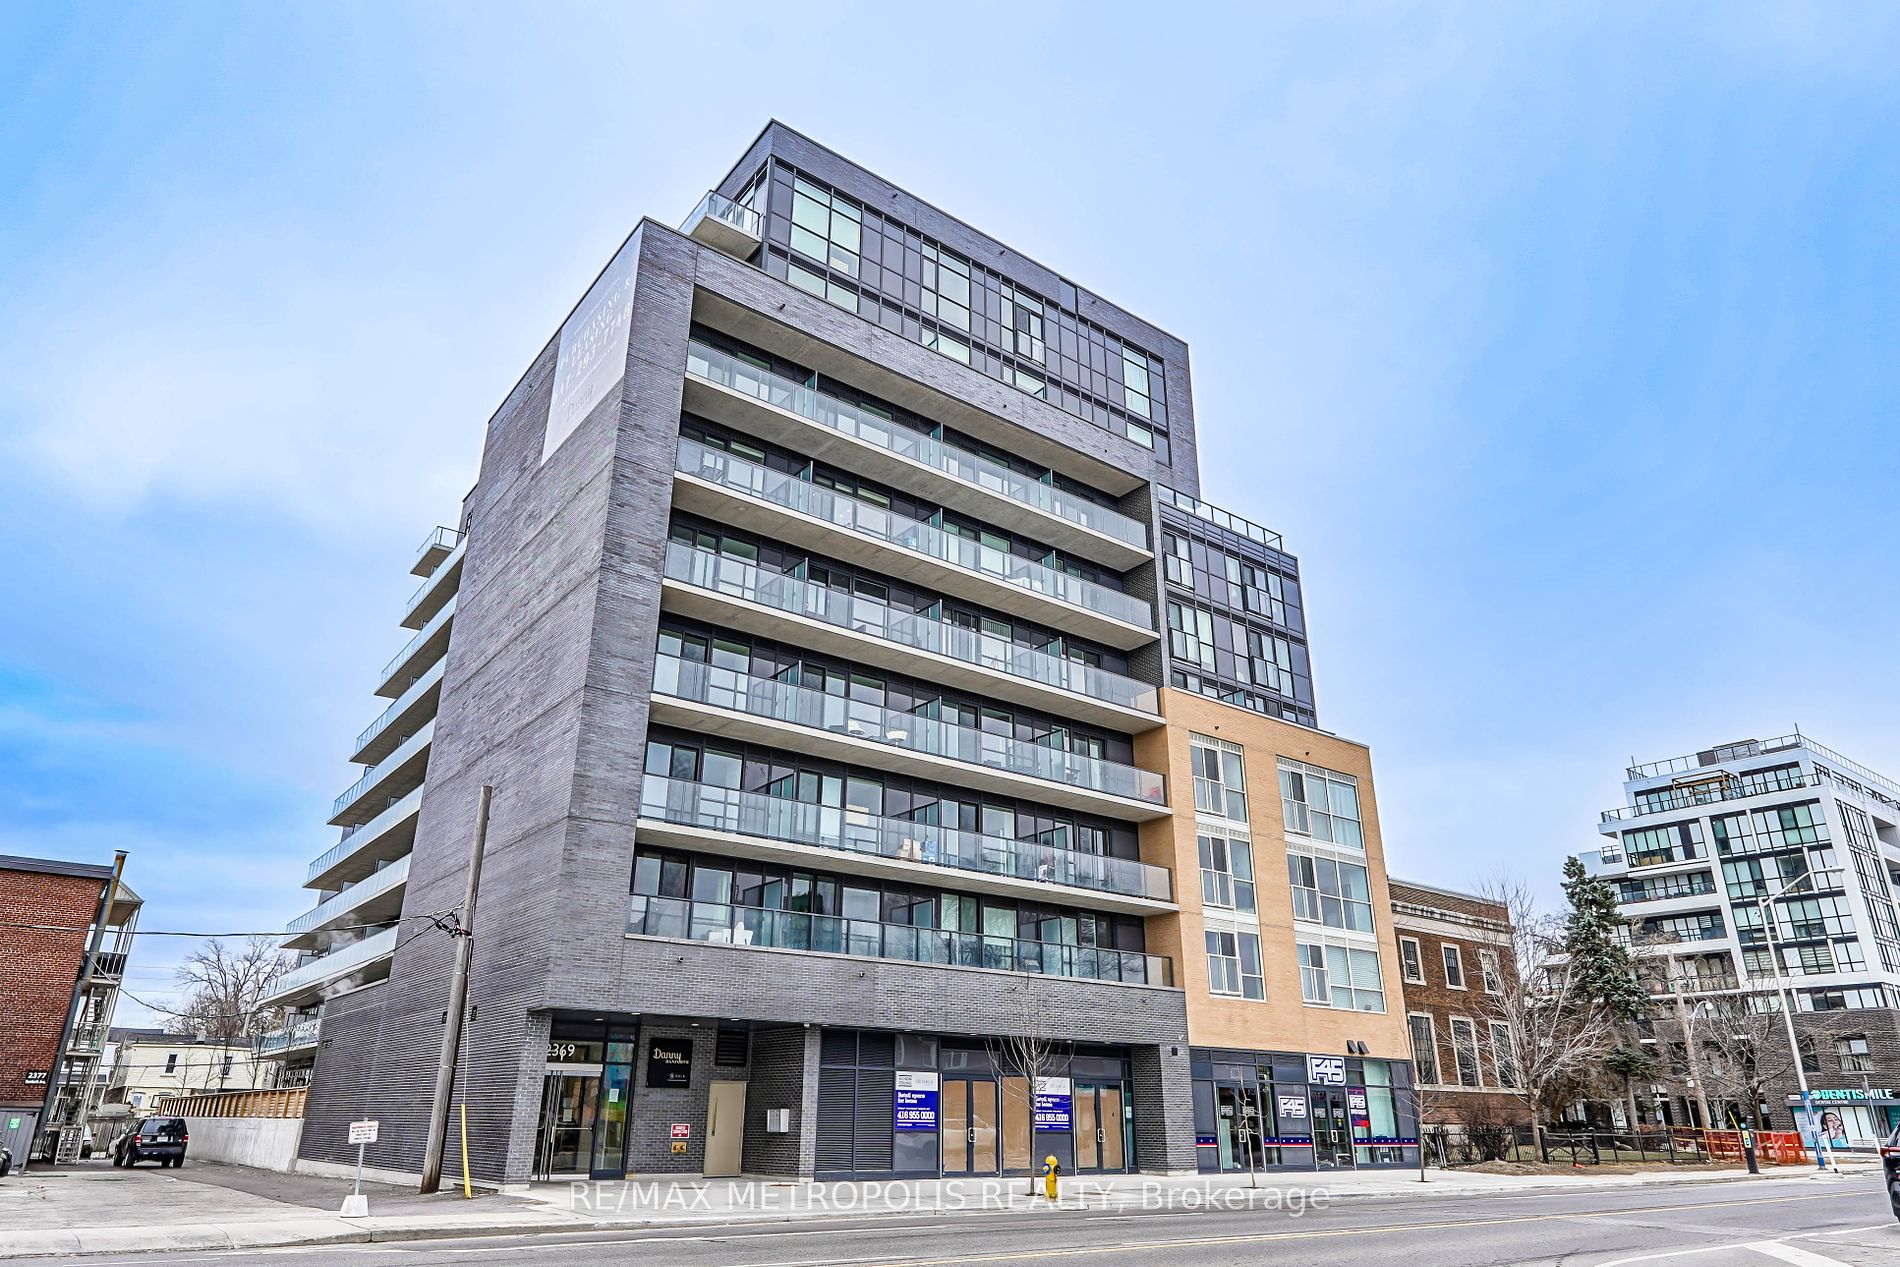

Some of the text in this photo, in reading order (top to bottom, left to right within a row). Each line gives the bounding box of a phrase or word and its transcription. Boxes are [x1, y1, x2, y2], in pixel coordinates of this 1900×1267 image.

[547, 1044, 576, 1061] 2369
[653, 1047, 682, 1064] Danny
[1309, 1056, 1345, 1084] F45
[1820, 1089, 1894, 1100] DENTISMILE
[897, 1110, 909, 1120] 416
[1279, 1097, 1306, 1118] F45
[1035, 1113, 1046, 1121] 416
